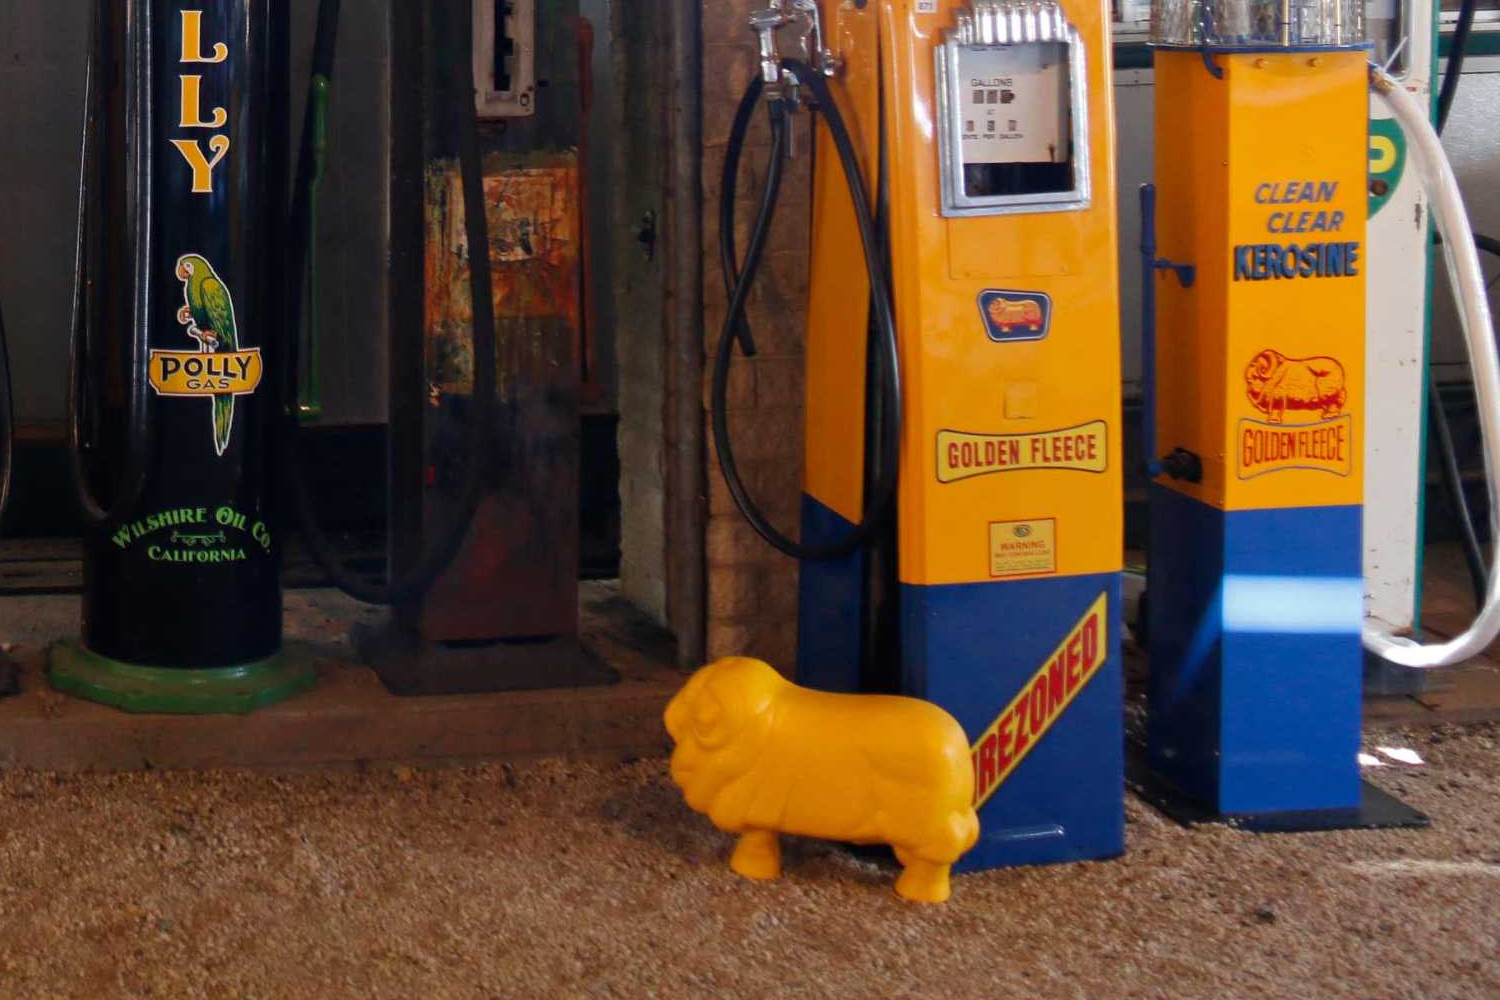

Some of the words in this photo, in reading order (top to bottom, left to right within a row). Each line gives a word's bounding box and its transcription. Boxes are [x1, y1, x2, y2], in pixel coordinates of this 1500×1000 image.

[1254, 181, 1339, 204] CLEAN
[1266, 210, 1345, 233] CLEAR
[1233, 241, 1360, 282] KEROSINE
[160, 355, 252, 382] POLLY
[187, 378, 230, 390] GAS
[947, 440, 1020, 469] GOLDEN
[1031, 434, 1097, 463] FLEECE
[1243, 428, 1296, 468] GOLDEN
[1299, 424, 1344, 462] FLEECE
[111, 507, 208, 549] WILSHIRE
[215, 506, 247, 531] OIL
[148, 545, 247, 563] CALIFORNIA
